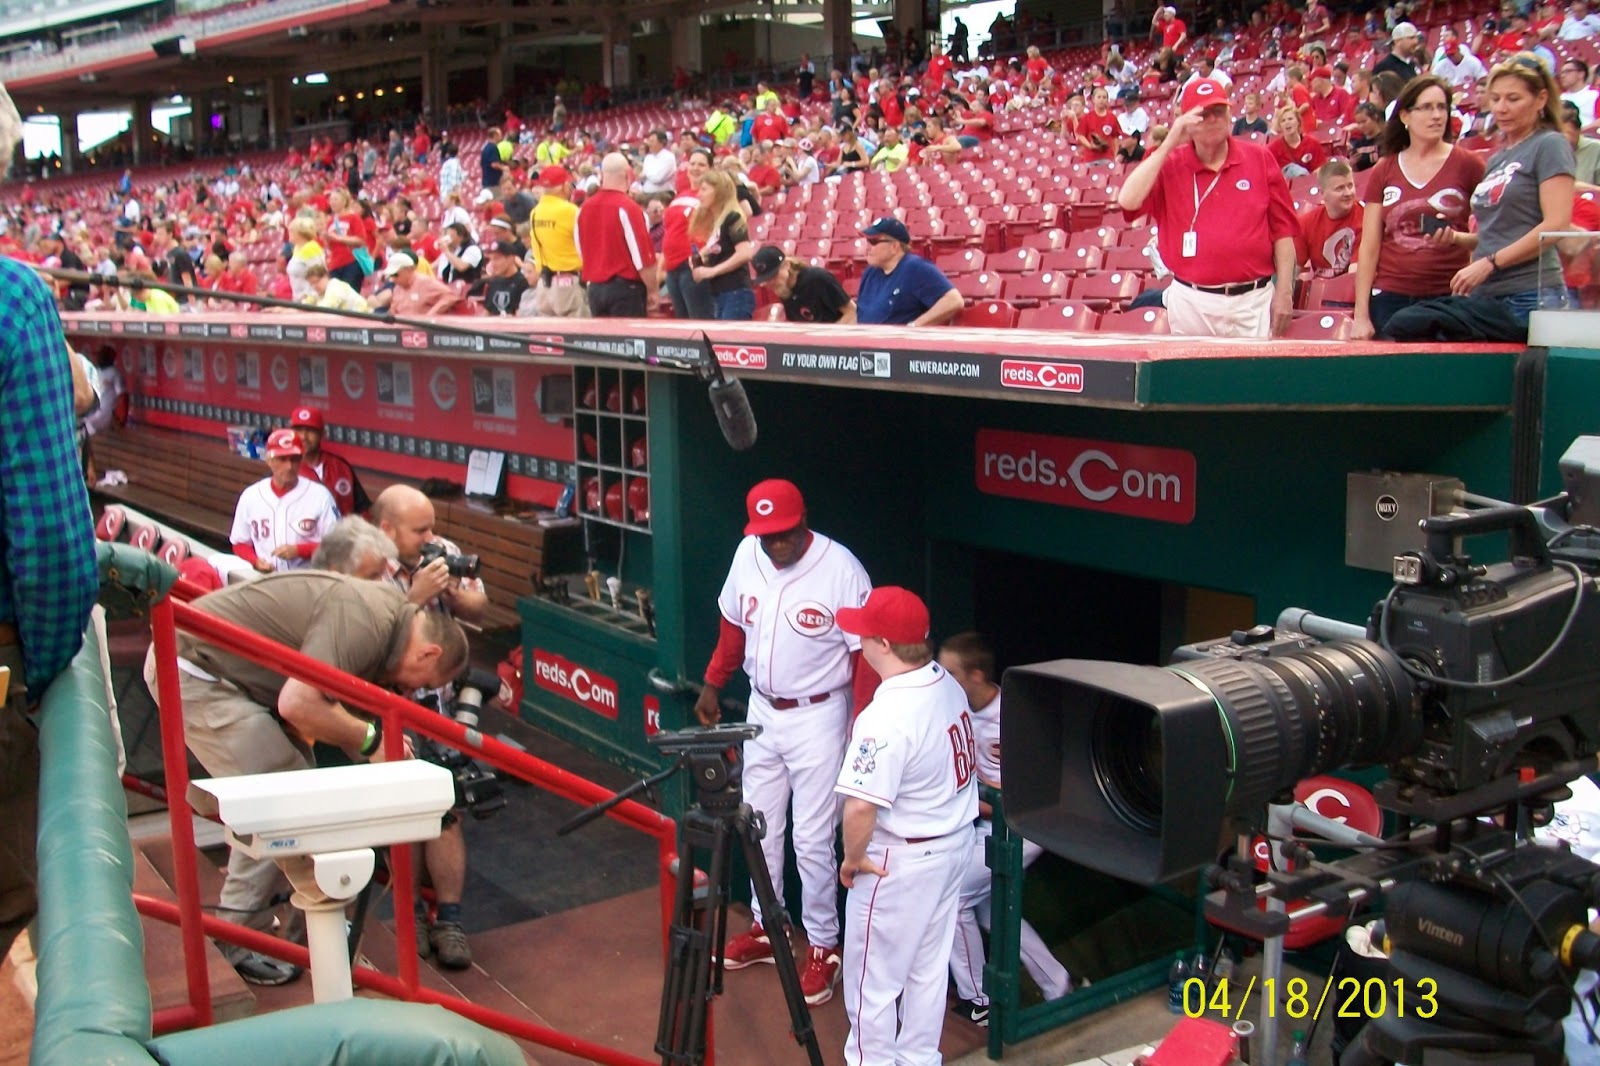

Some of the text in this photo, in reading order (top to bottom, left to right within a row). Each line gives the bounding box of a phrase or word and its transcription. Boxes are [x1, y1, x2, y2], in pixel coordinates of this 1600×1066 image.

[782, 352, 795, 366] FLY
[797, 353, 818, 368] YOUR
[818, 354, 837, 369] OWN
[838, 355, 858, 370] FLAG
[909, 360, 980, 378] NEWERACAP.COM
[1003, 365, 1080, 387] reds.Com
[984, 449, 1181, 503] reds.Com
[739, 594, 759, 628] 12
[535, 659, 616, 709] reds.Com
[1418, 917, 1464, 946] Vinten
